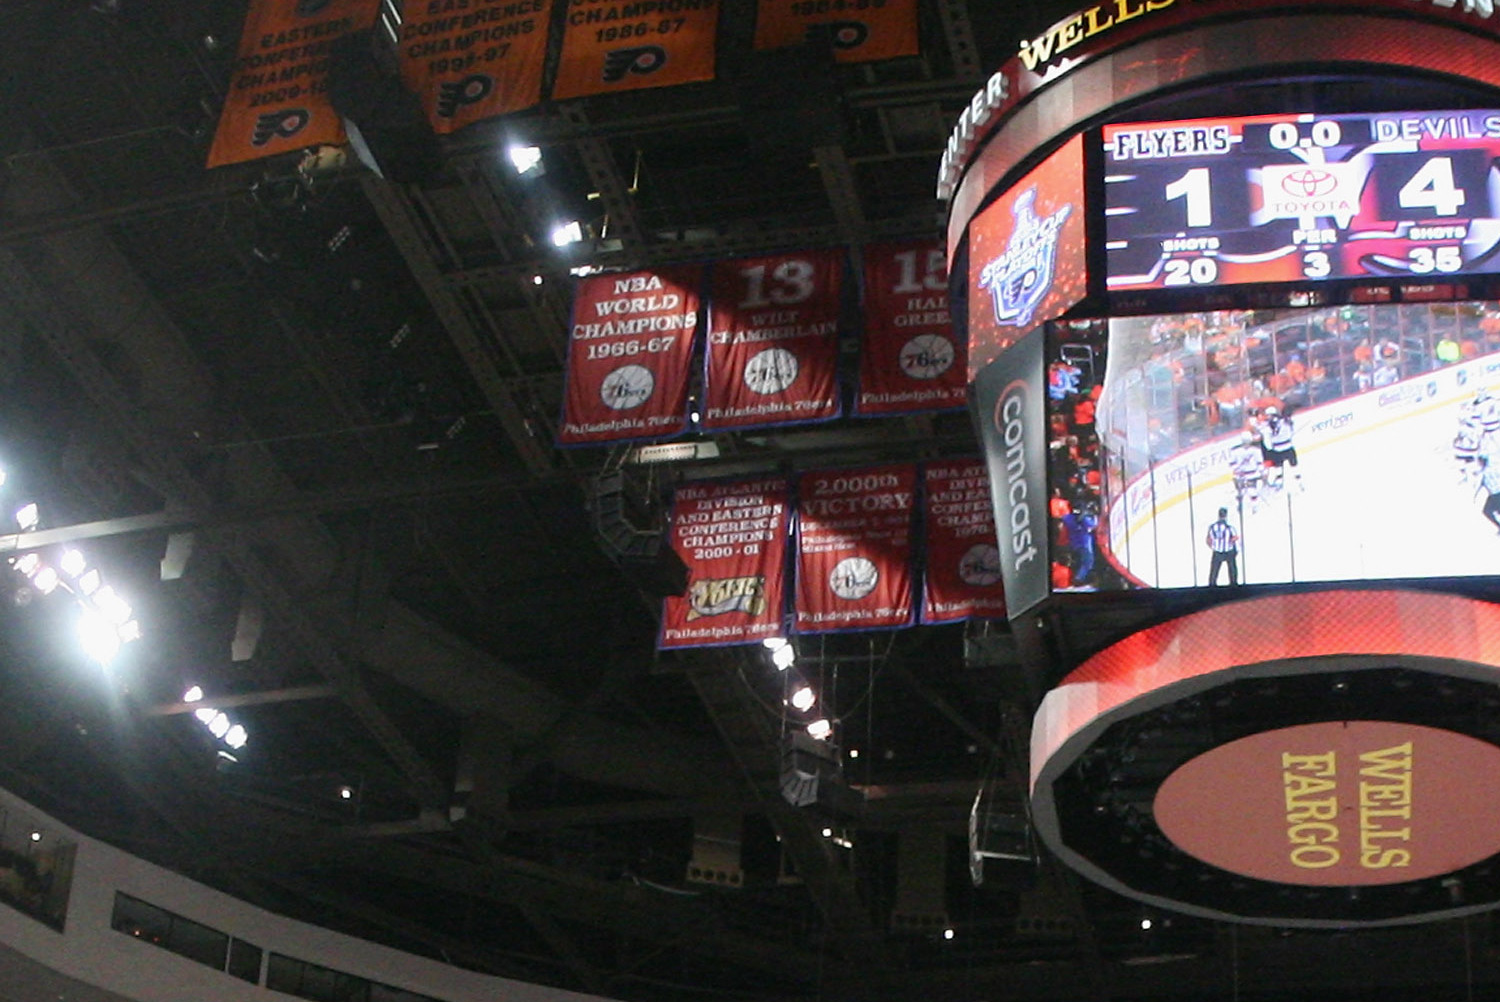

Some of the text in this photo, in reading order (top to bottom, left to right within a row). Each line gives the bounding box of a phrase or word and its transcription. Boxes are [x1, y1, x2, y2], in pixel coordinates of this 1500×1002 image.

[595, 17, 685, 44] 1986-87
[1113, 126, 1231, 160] FLYERS
[1270, 117, 1340, 150] 0.0
[1166, 168, 1211, 227] 1
[1400, 156, 1465, 216] 4
[1273, 200, 1351, 215] TOYOTA
[1293, 229, 1337, 245] PER
[1164, 257, 1217, 286] 20
[1303, 251, 1331, 278] 3
[1408, 246, 1463, 274] 35
[614, 275, 664, 295] NBA
[737, 260, 816, 309] 13
[596, 294, 680, 316] WORLD
[572, 311, 697, 340] CHAMPIONS
[588, 336, 677, 360] 1966-67
[712, 504, 783, 521] EASTERN
[803, 493, 911, 516] VICTORY
[679, 517, 779, 538] CONFERENCE
[683, 532, 773, 549] CHAMPIONS
[1282, 741, 1413, 870] WELLS FARGO
